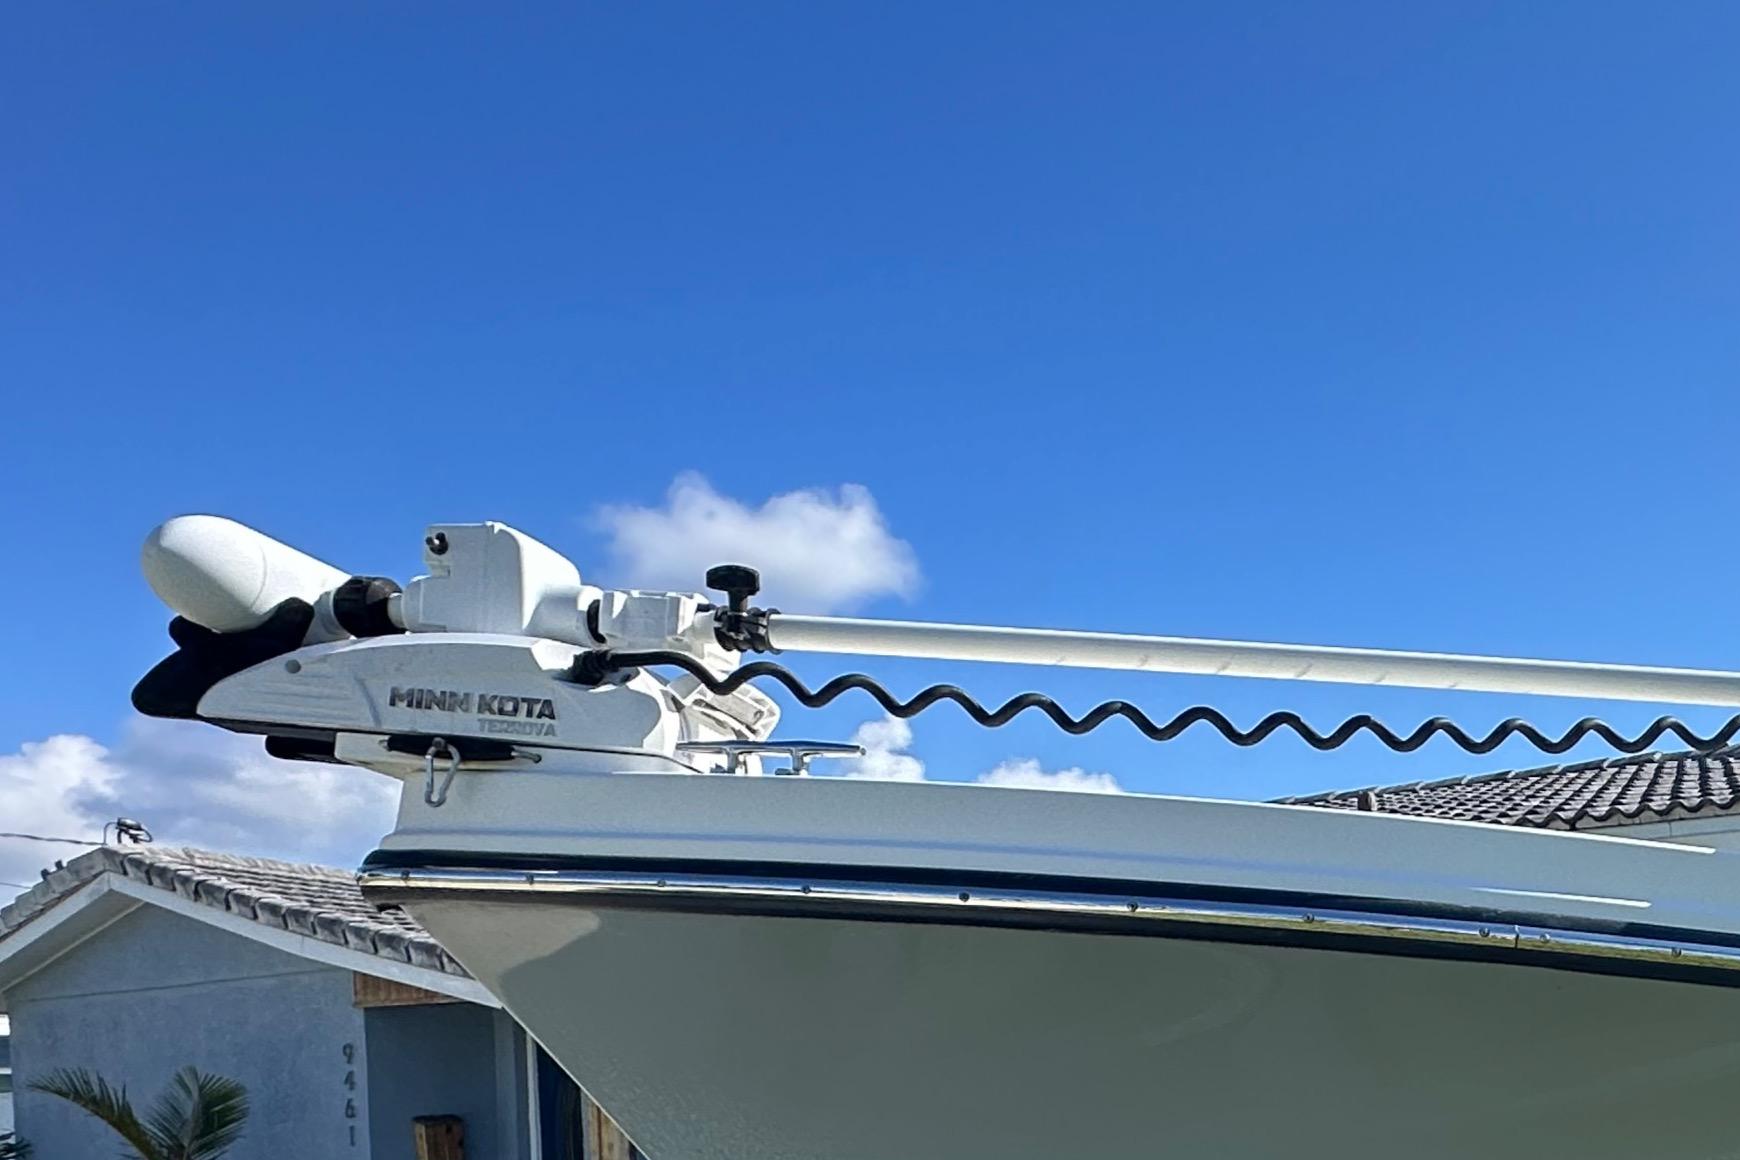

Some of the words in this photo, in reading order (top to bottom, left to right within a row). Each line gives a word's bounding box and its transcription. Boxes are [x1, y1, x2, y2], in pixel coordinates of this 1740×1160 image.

[388, 686, 471, 713] MINN
[477, 693, 557, 720] KOTA
[342, 1042, 357, 1148] 9461
